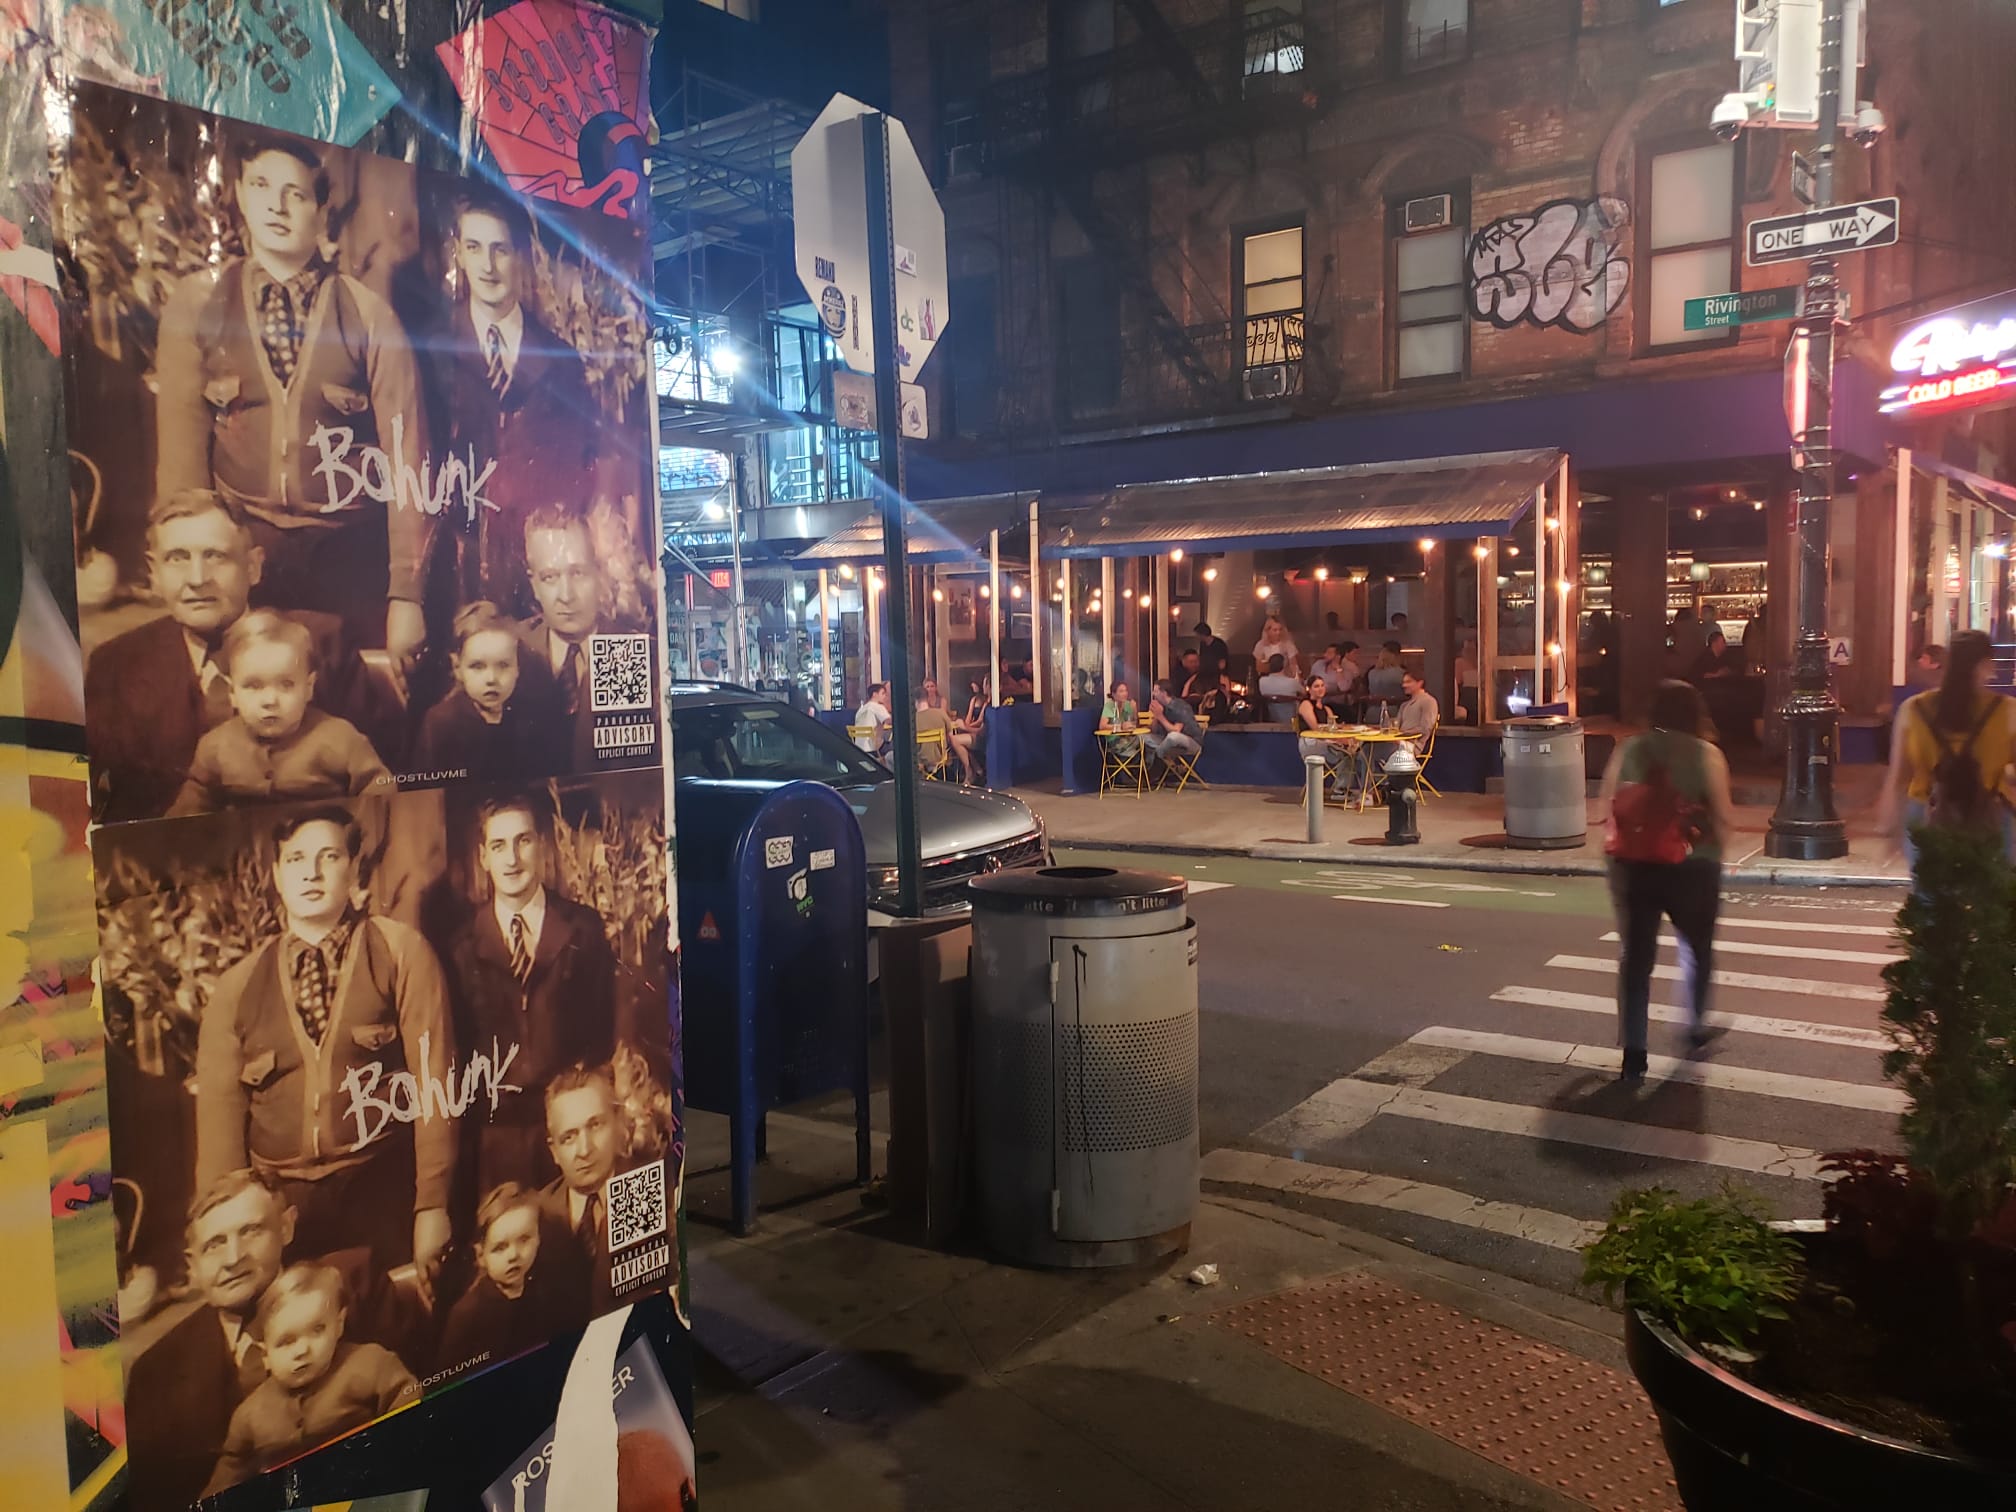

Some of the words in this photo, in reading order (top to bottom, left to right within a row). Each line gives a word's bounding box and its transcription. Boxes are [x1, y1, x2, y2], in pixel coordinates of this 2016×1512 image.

[1761, 228, 1804, 249] ONE
[1829, 215, 1876, 239] WAY
[1704, 293, 1777, 316] Rivington
[1704, 314, 1730, 326] Street
[306, 413, 501, 525] Bohunk
[1833, 642, 1849, 658] A
[596, 714, 651, 727] PARENTAL
[596, 725, 653, 746] ADVISORY
[598, 747, 625, 760] EXPLICIT
[626, 745, 652, 757] CONTENT
[375, 768, 468, 785] GHOSTLUVME
[338, 1030, 523, 1153] Bohunk
[614, 1237, 666, 1265] PARENTAL
[613, 1248, 667, 1285] ADVISORY
[615, 1278, 640, 1297] EXPLICIT
[642, 1266, 667, 1285] CONTENT
[403, 1350, 491, 1395] GHOSTLUVME
